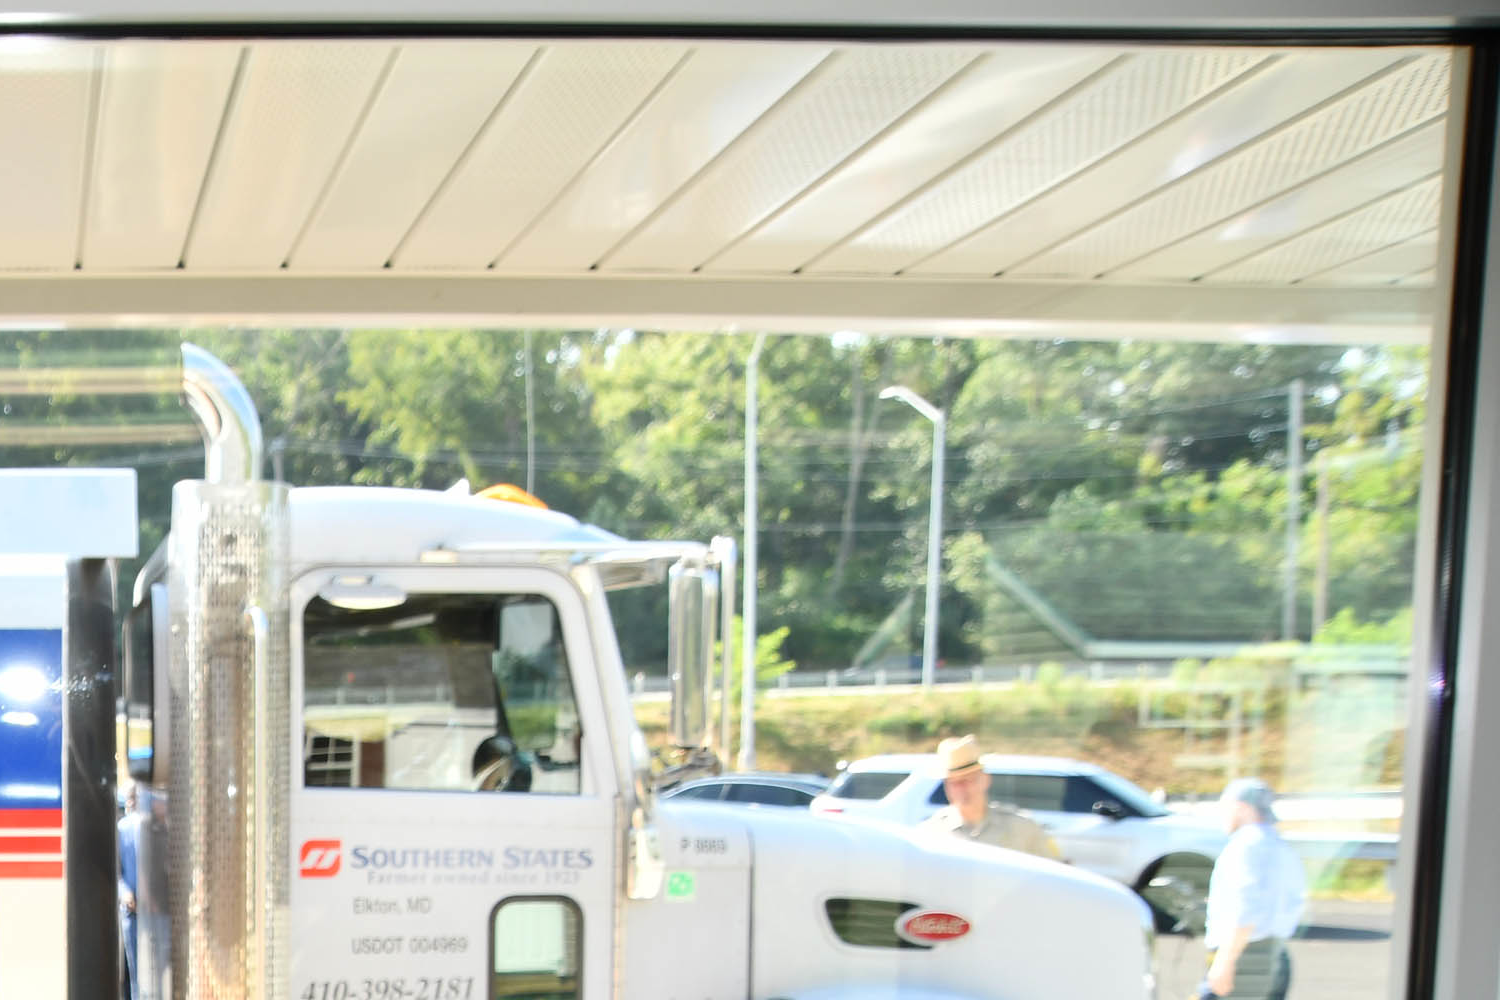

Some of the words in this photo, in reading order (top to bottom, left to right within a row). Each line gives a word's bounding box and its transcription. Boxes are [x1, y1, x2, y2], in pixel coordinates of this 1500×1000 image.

[350, 846, 494, 869] SOUTHERN
[504, 845, 593, 868] STATES
[367, 872, 425, 885] Farmer
[432, 872, 487, 884] owned
[495, 871, 541, 884] since
[406, 897, 432, 913] MD
[351, 937, 404, 954] USDOT
